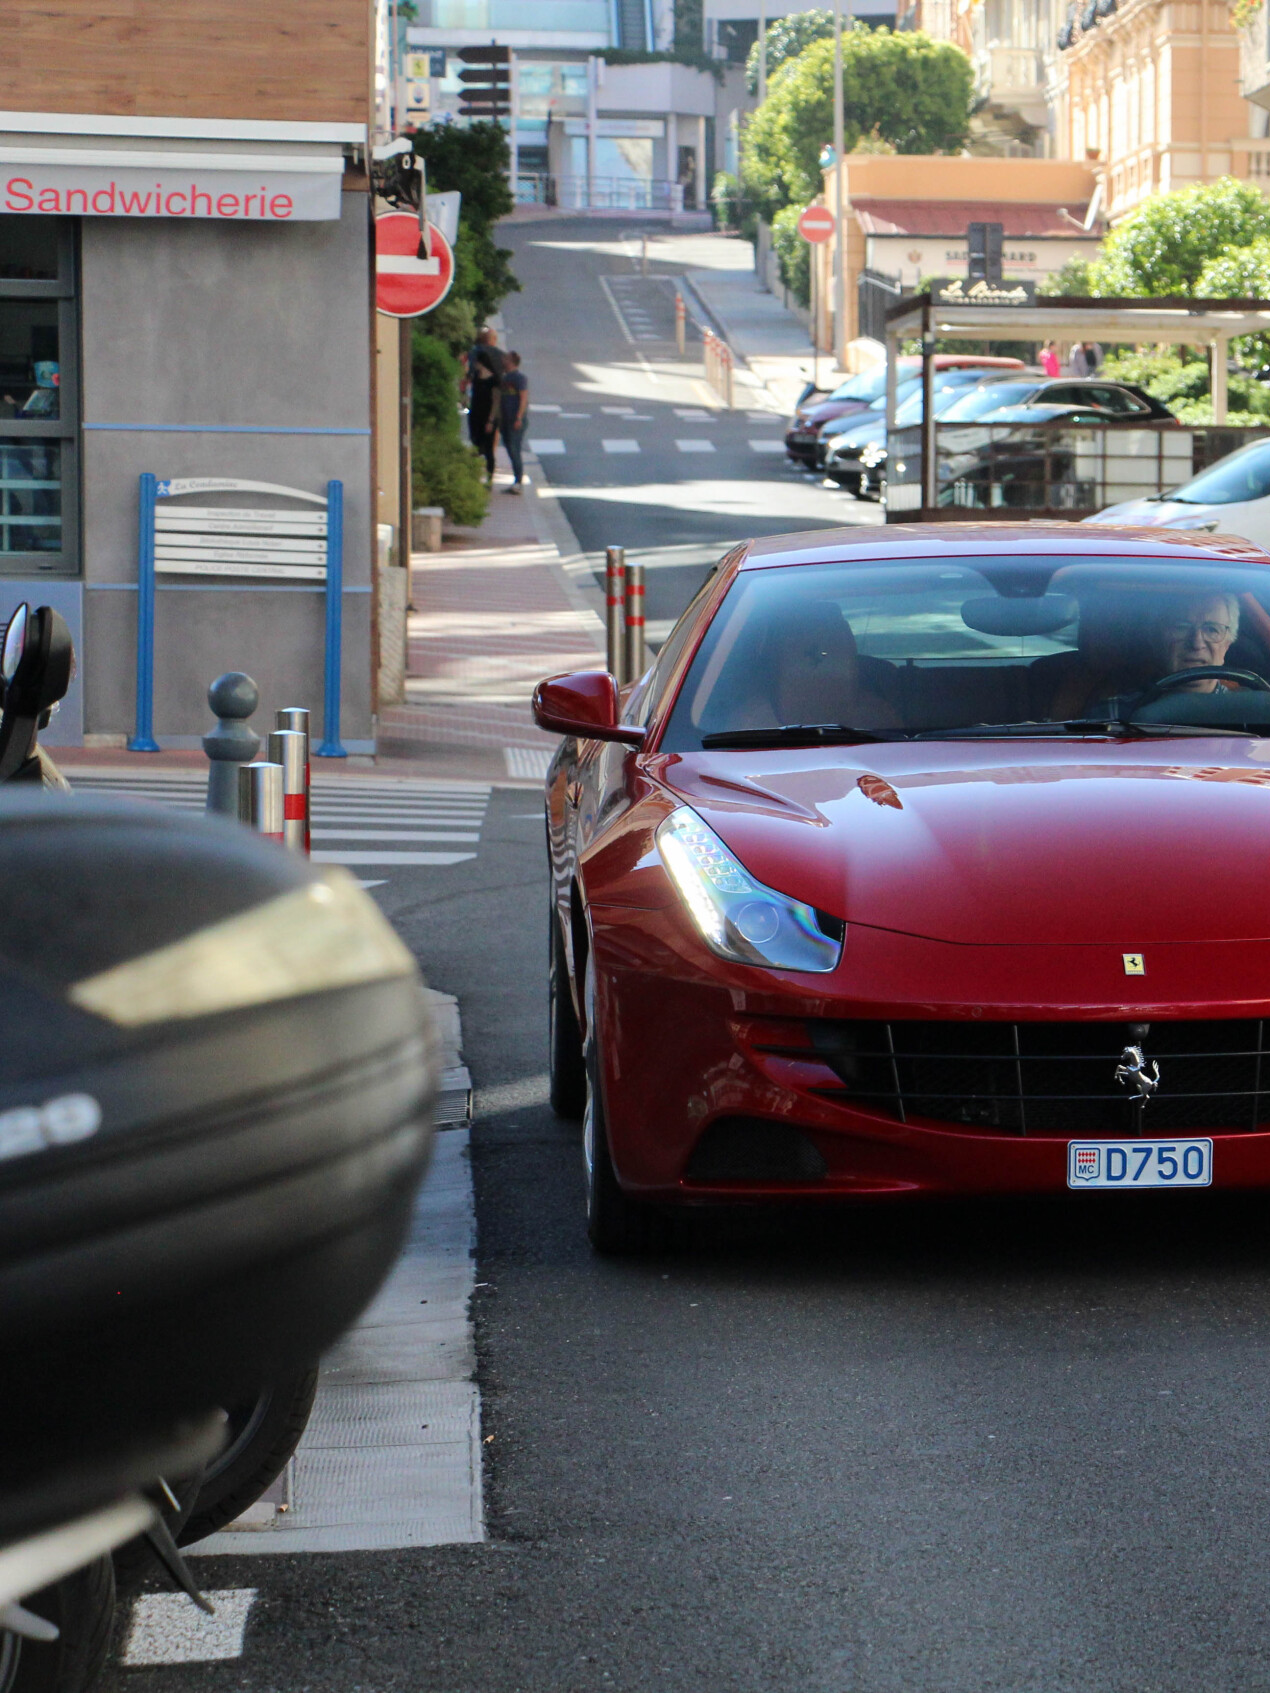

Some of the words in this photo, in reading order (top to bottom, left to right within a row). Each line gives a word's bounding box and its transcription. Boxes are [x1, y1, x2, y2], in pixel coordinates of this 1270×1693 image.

[5, 177, 294, 219] Sandwicherie
[1078, 1165, 1095, 1174] MC
[1106, 1145, 1204, 1181] D750
